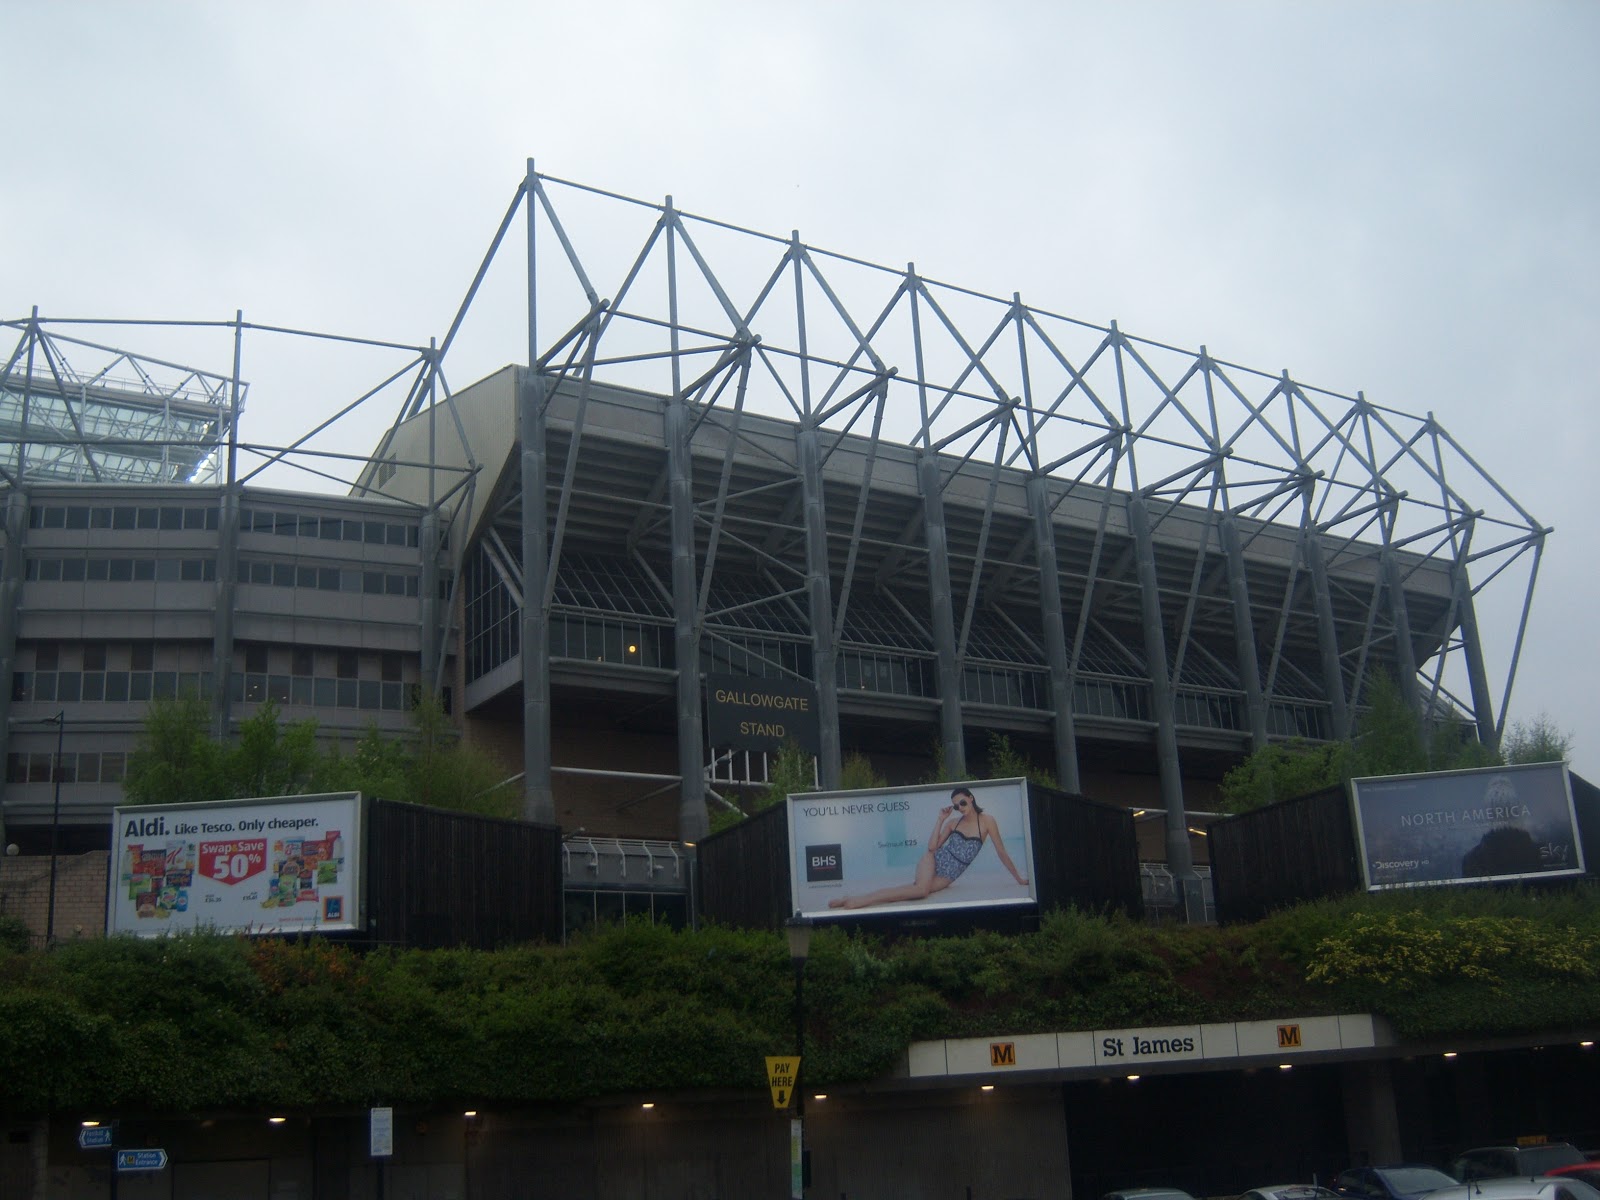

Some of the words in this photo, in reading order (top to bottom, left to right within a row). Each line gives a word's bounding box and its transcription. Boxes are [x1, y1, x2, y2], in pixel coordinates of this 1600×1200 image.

[716, 689, 808, 711] GALLOWGATE
[740, 721, 785, 738] STAND
[803, 806, 839, 817] YOU'LL
[842, 804, 874, 815] NEVER
[877, 801, 910, 813] GUESS
[1401, 812, 1456, 827] NORTH
[1462, 805, 1532, 822] AMERICA
[125, 816, 170, 837] Aldi.
[174, 822, 198, 835] Like
[201, 822, 235, 834] Tesco.
[238, 819, 265, 833] Only
[268, 817, 319, 832] cheaper.
[811, 855, 837, 867] BHS
[1278, 1025, 1300, 1045] M
[992, 1043, 1014, 1063] M
[1102, 1038, 1124, 1056] St
[1131, 1036, 1194, 1056] James
[774, 1063, 790, 1074] PAY
[771, 1076, 792, 1087] HERE
